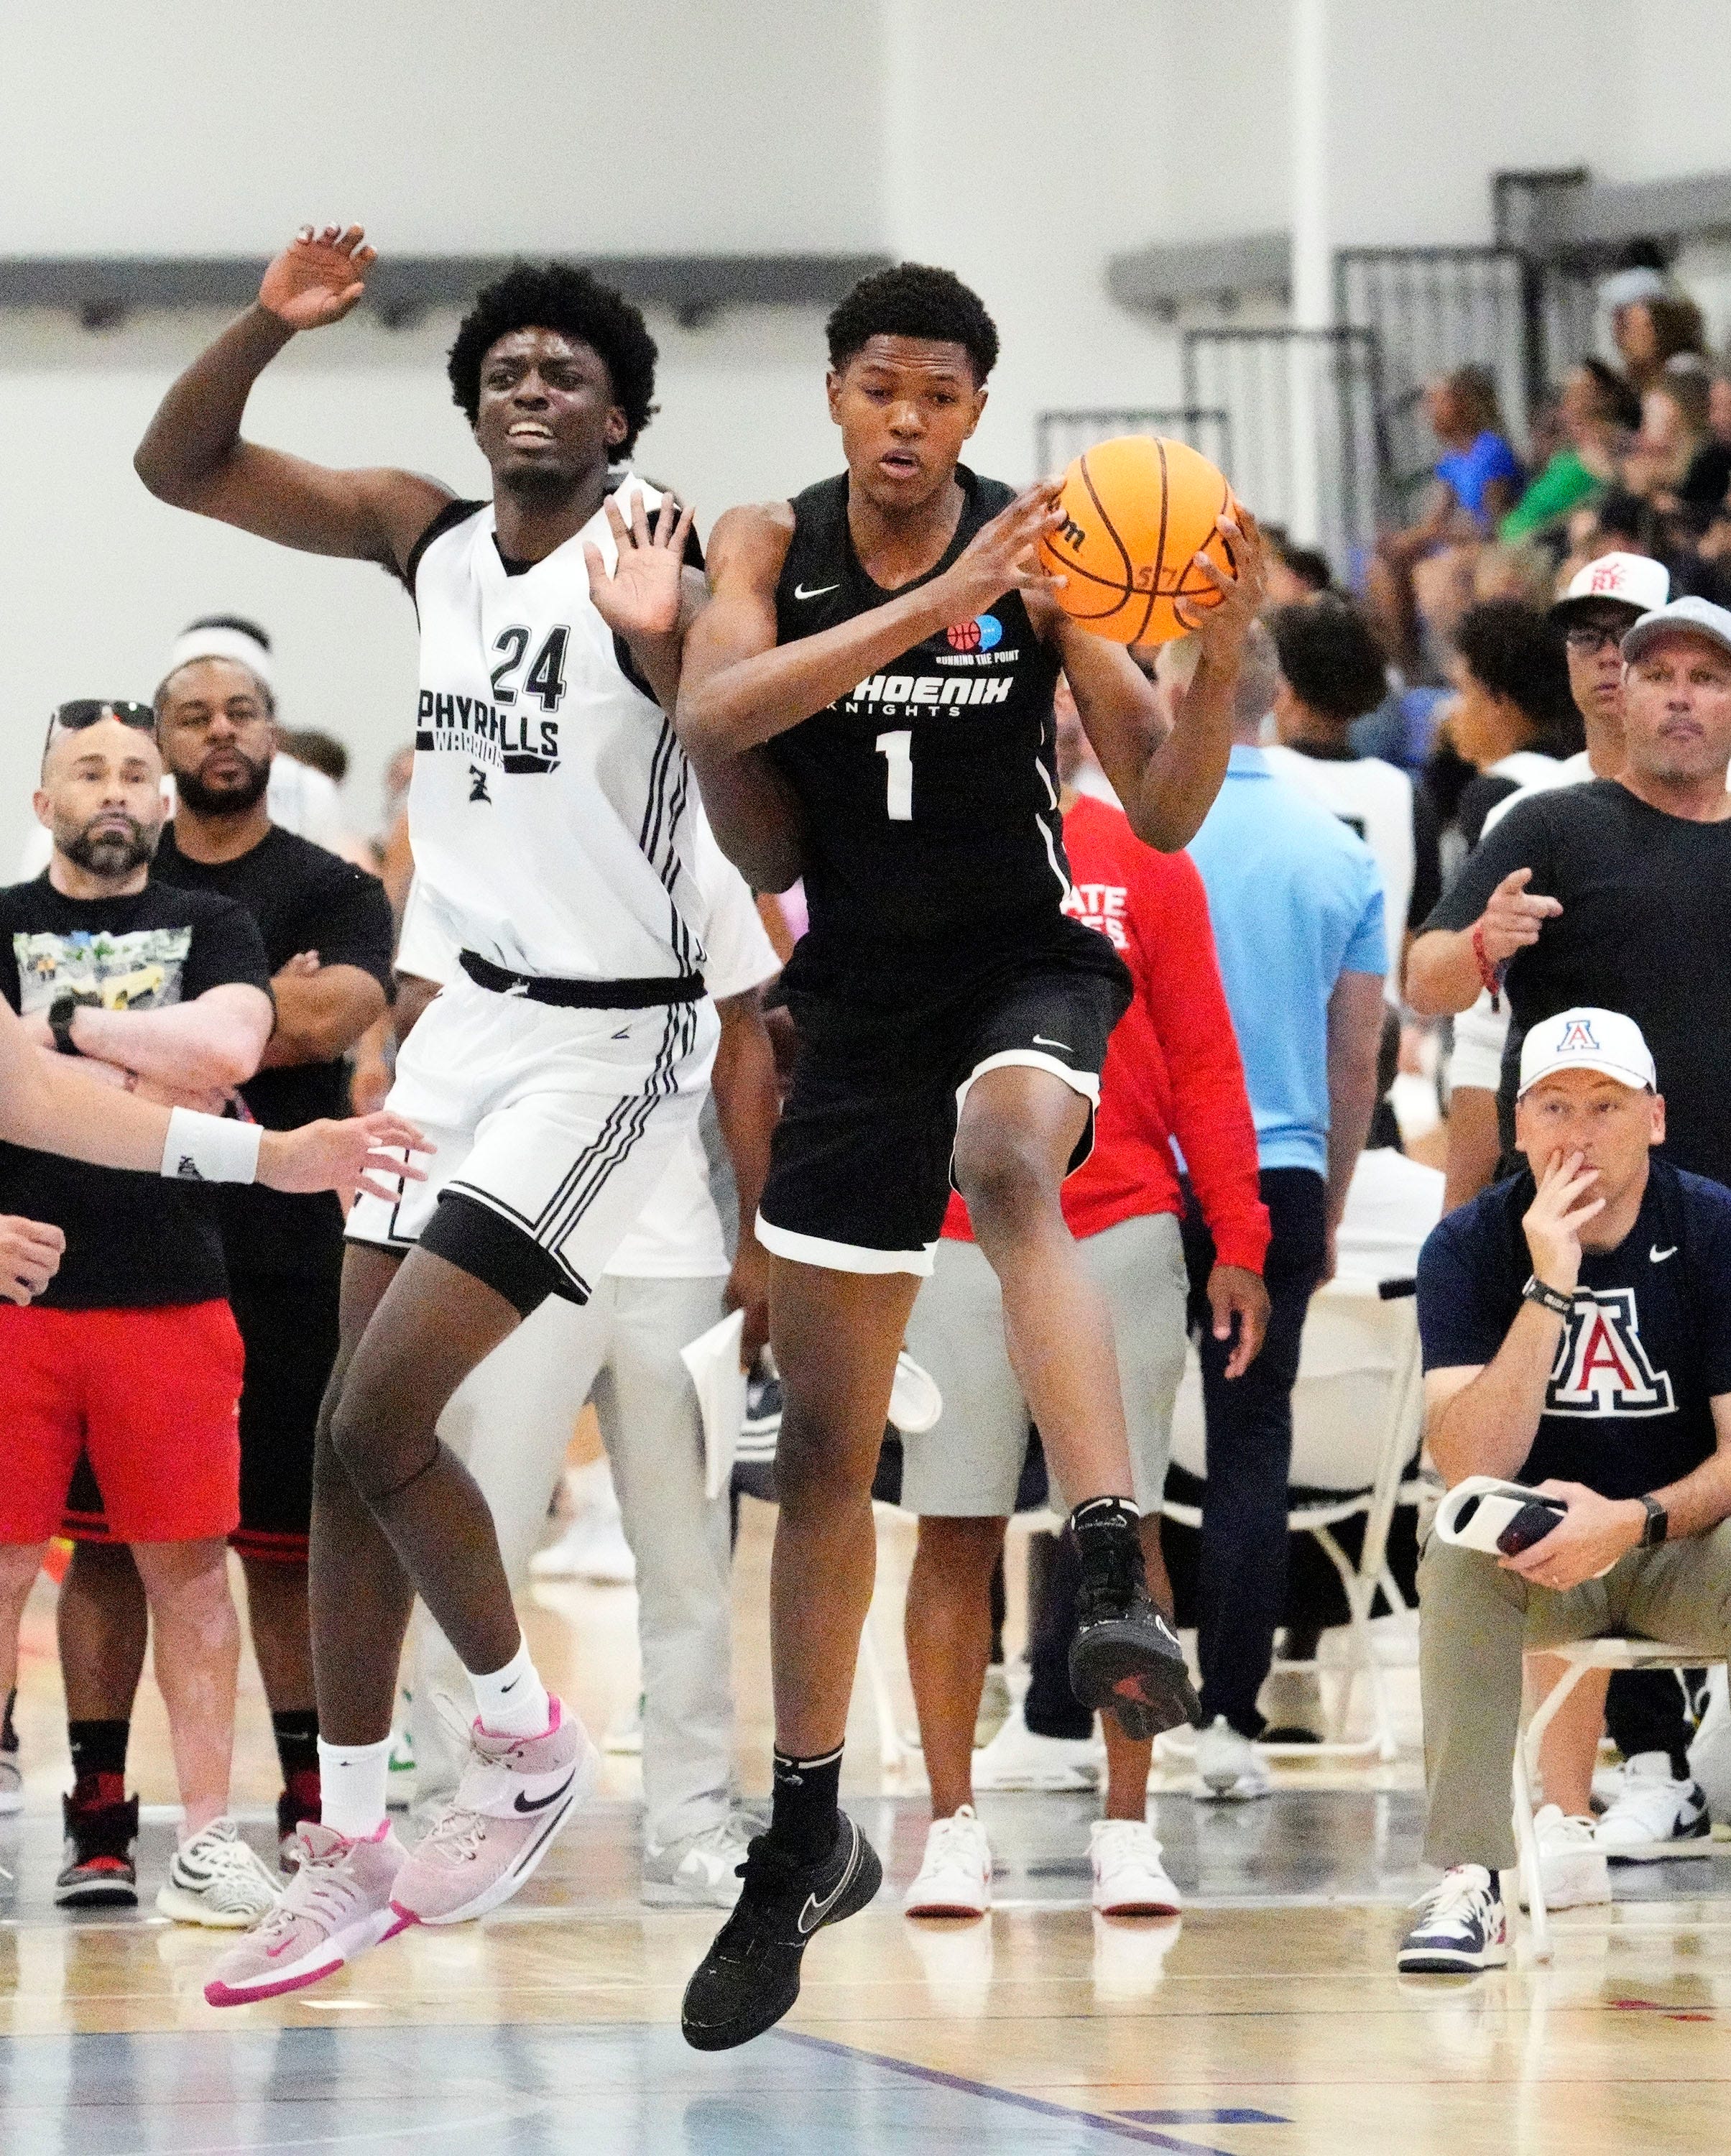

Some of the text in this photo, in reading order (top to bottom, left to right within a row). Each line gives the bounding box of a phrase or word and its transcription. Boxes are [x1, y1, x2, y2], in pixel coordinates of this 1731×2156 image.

[490, 624, 571, 713] 24
[936, 649, 1020, 665] RUNNING THE POINT
[852, 675, 1015, 705] HOENIX
[875, 730, 913, 821] 1
[1556, 1020, 1600, 1052] A
[1541, 1286, 1678, 1419] A
